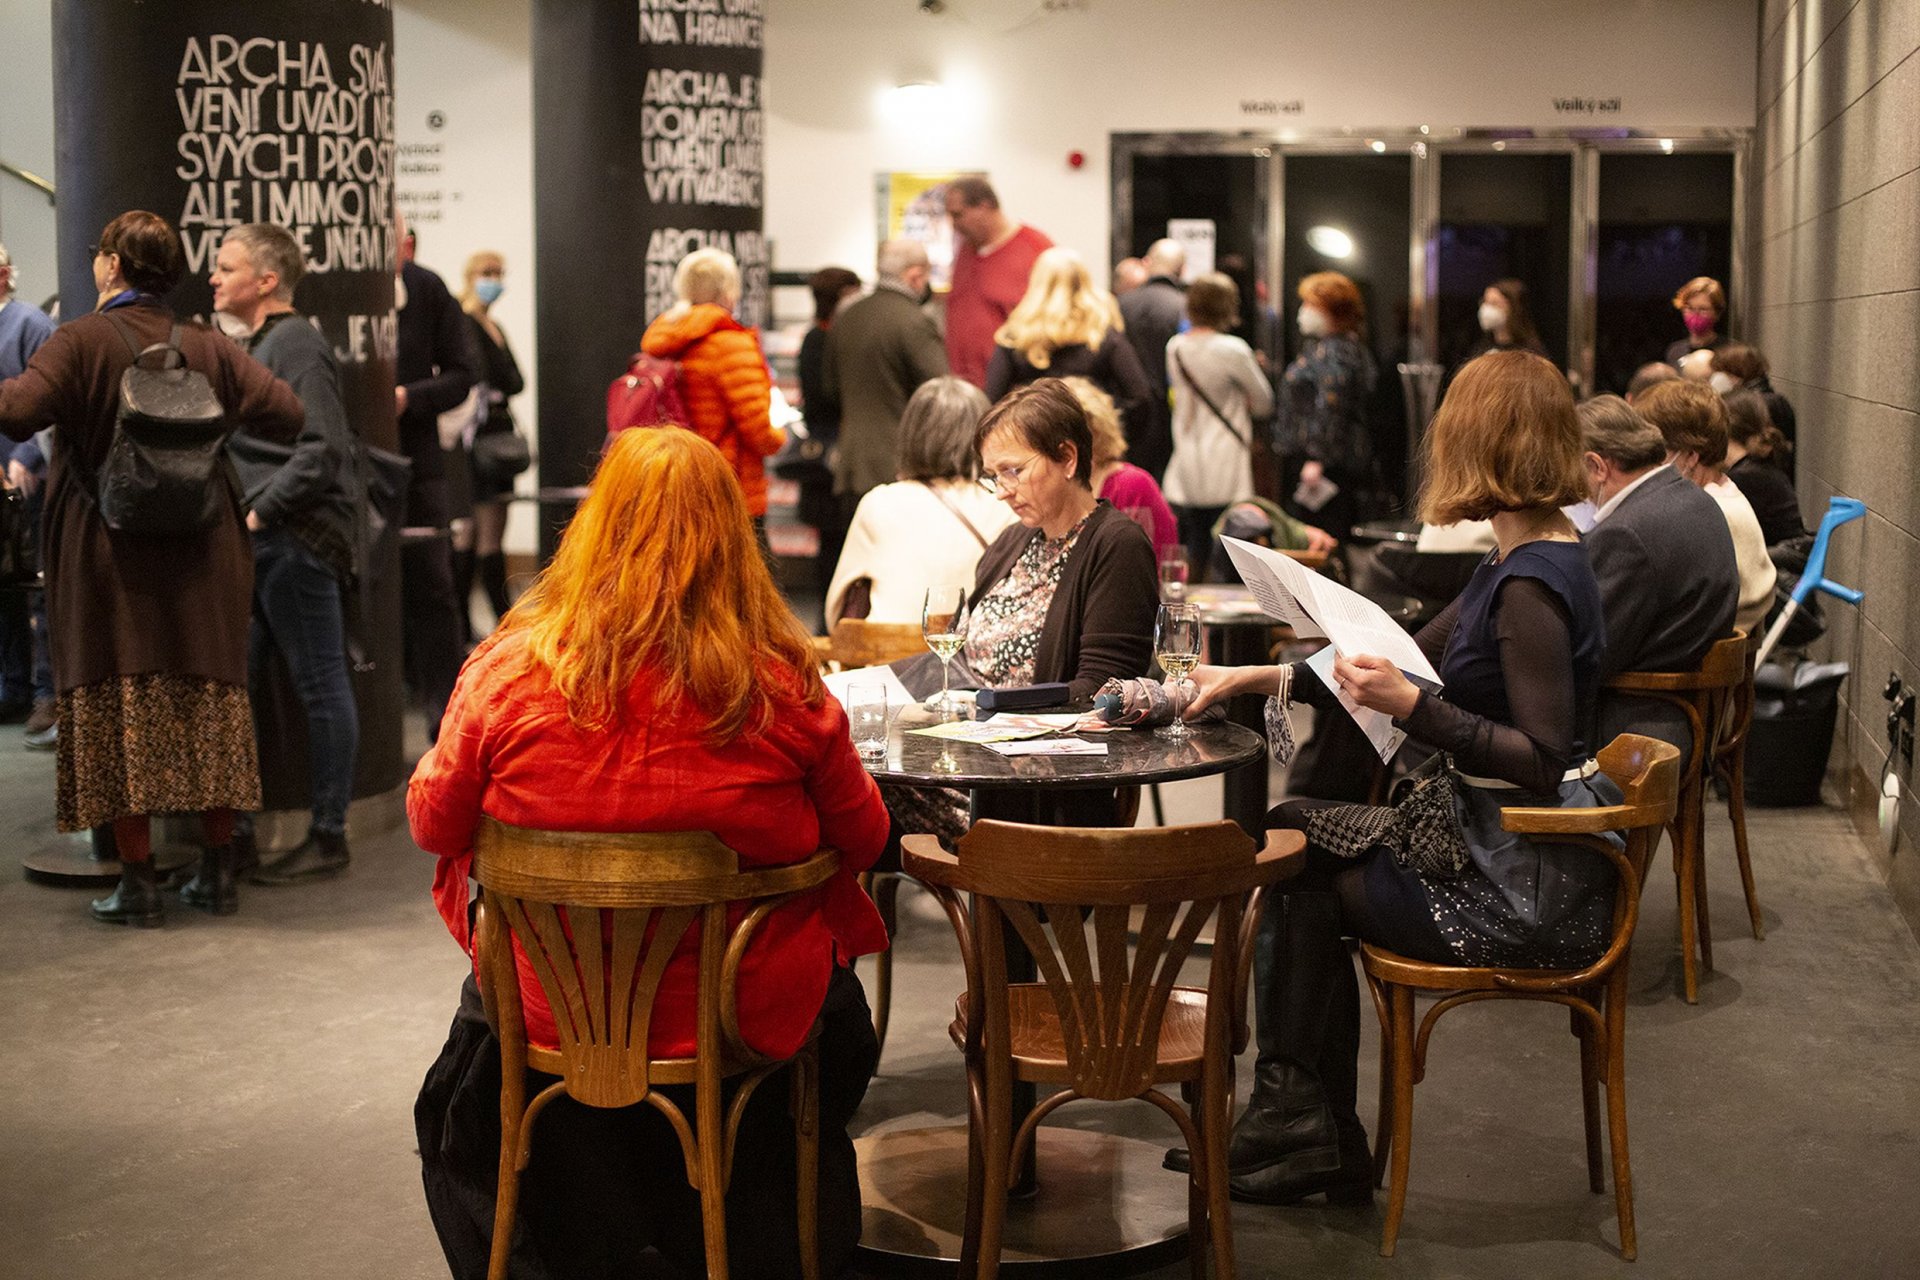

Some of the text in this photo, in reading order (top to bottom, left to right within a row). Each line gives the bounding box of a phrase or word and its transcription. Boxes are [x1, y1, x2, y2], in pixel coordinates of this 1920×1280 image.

[177, 34, 336, 88] ARCHA
[642, 68, 732, 107] ARCHA
[180, 181, 244, 227] ALE
[269, 181, 365, 228] MIMO
